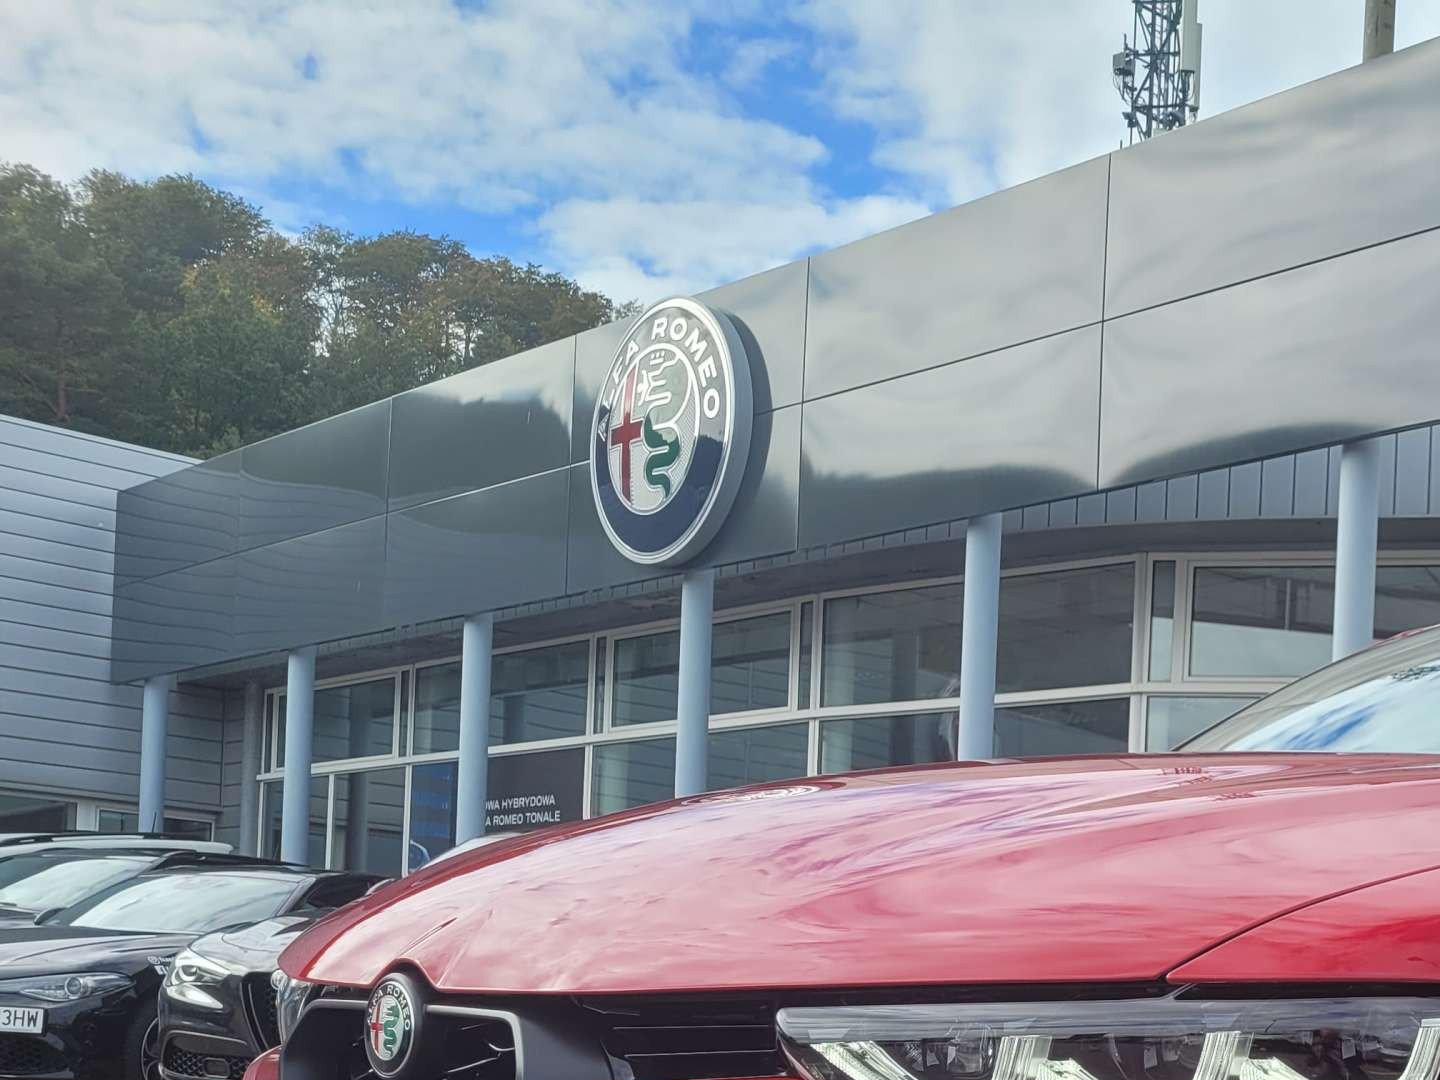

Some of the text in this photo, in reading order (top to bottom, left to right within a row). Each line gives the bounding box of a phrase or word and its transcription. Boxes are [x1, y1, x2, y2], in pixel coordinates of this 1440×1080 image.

[598, 316, 720, 442] ALFA ROMEO
[501, 794, 556, 809] HYBRYDOWA
[493, 813, 524, 826] ROMEO
[525, 810, 561, 824] TONALE
[386, 984, 411, 1031] ROMEO
